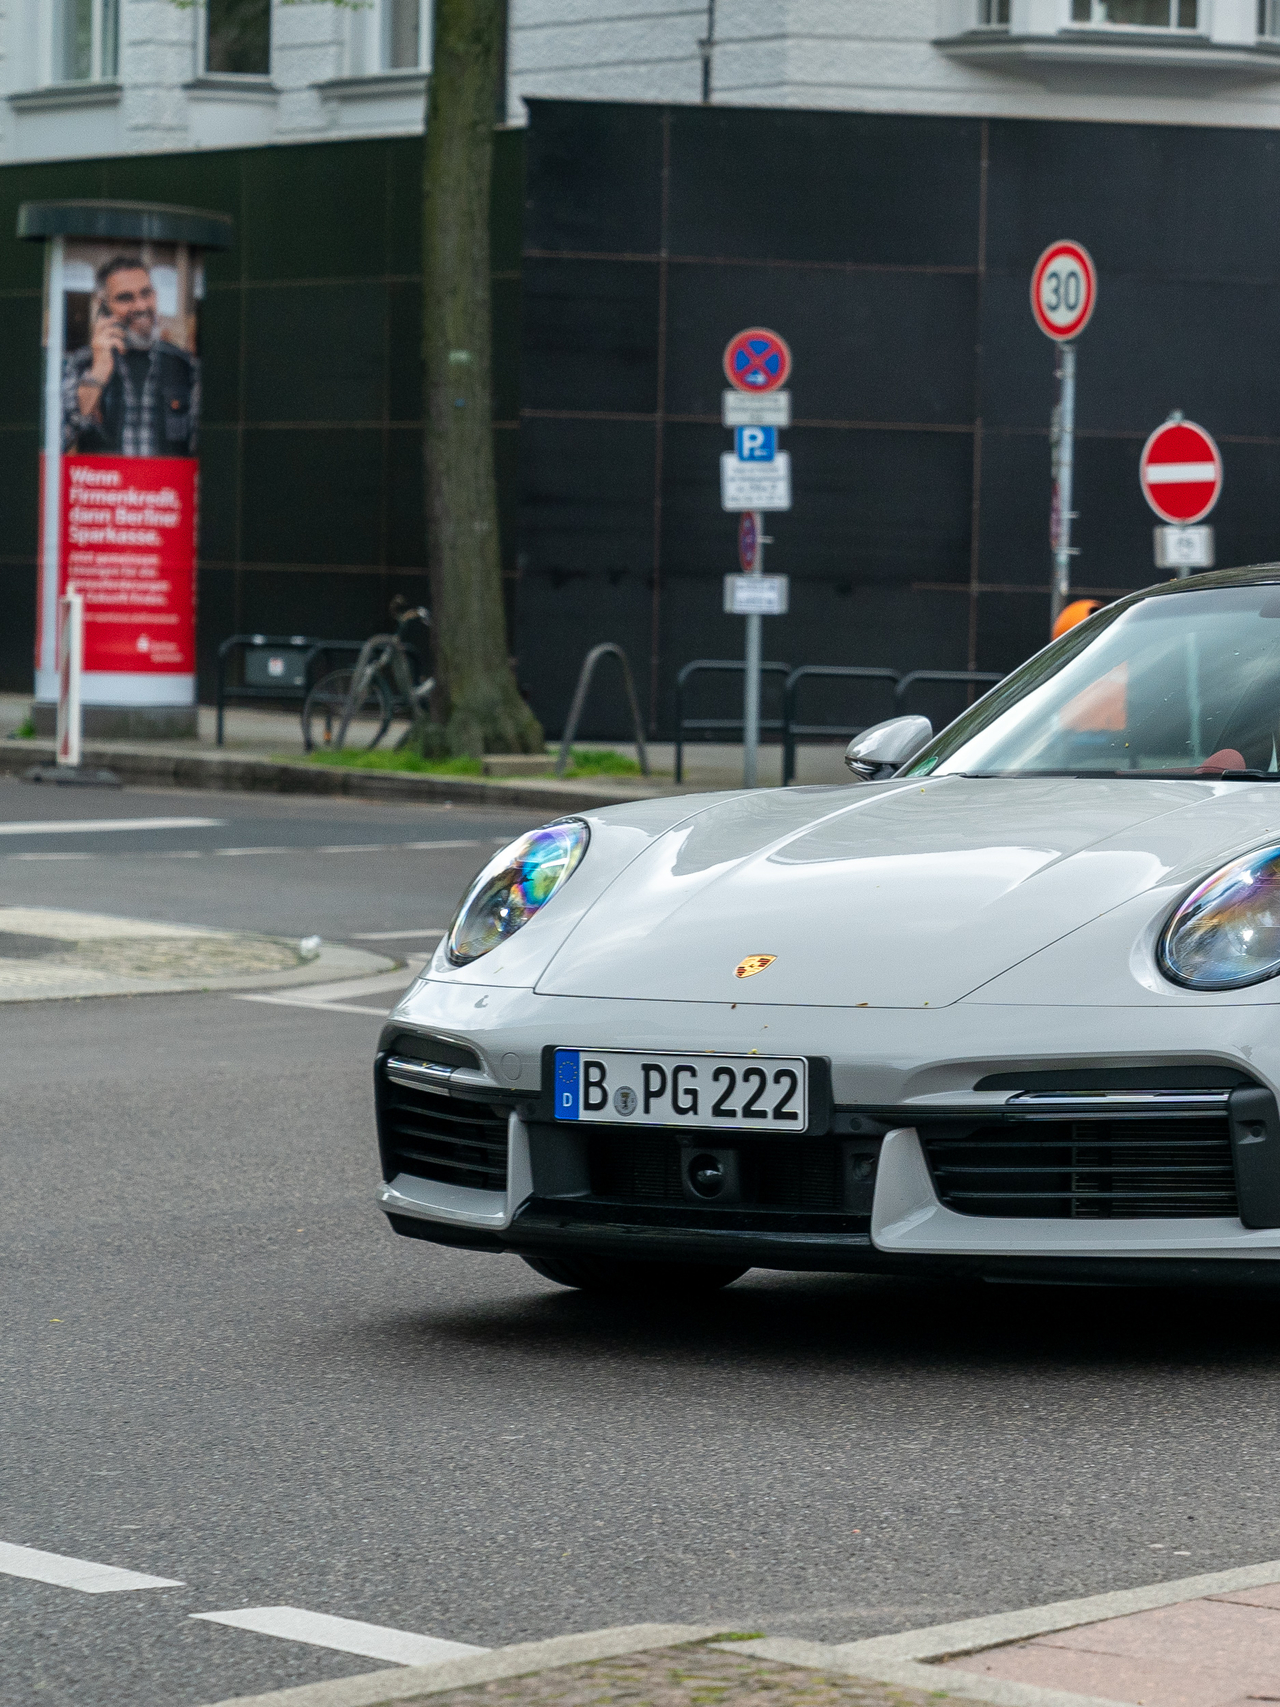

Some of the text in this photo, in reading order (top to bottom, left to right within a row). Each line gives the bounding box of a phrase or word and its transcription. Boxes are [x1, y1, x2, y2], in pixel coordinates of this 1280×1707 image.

[1044, 271, 1082, 312] 30
[742, 426, 765, 459] P
[70, 466, 121, 486] Wenn
[69, 507, 111, 525] dann
[562, 1092, 573, 1107] D
[583, 1060, 608, 1111] B
[641, 1062, 699, 1116] PG
[711, 1066, 799, 1120] 222
